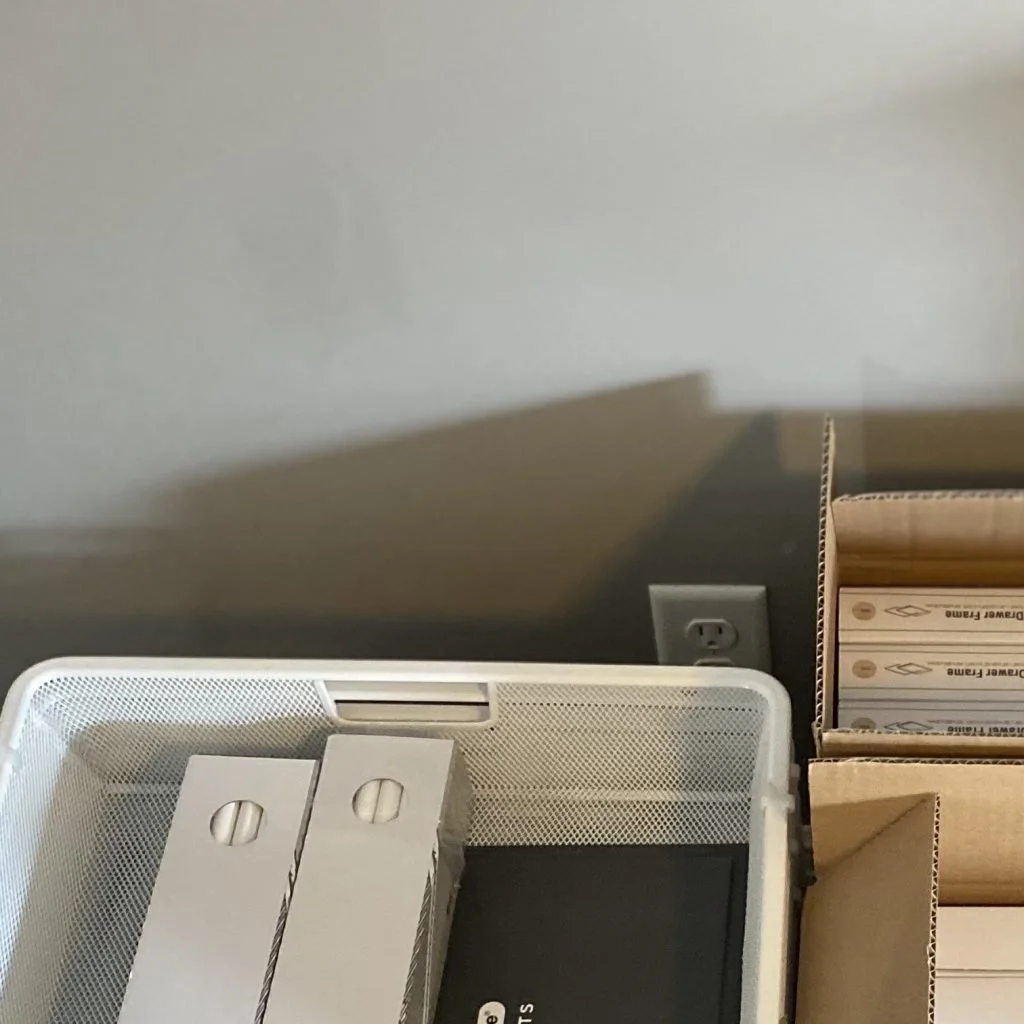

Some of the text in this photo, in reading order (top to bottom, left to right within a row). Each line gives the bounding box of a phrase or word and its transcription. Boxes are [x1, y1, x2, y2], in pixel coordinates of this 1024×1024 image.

[945, 610, 1024, 621] Drawer Frame
[947, 668, 983, 678] Frame
